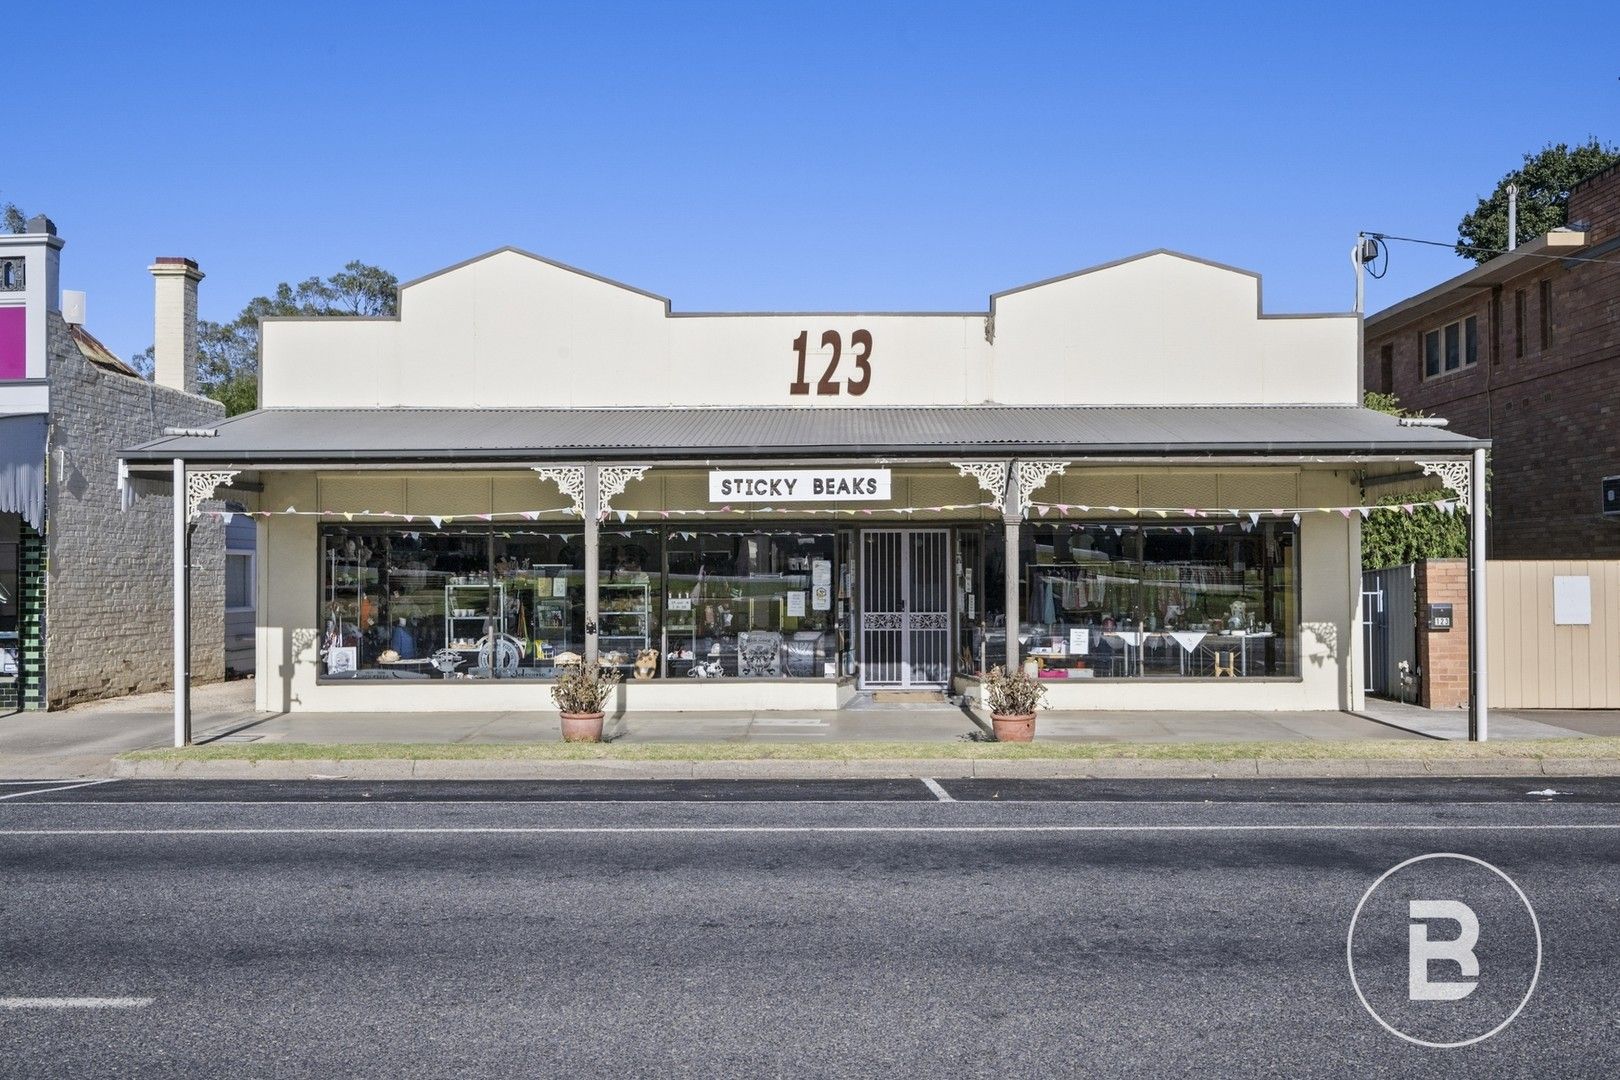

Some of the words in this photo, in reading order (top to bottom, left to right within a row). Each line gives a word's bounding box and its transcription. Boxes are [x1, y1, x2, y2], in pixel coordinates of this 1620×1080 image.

[789, 329, 873, 397] 123
[720, 478, 798, 496] STICKY
[812, 477, 878, 496] BEAKS
[1435, 617, 1450, 626] 123
